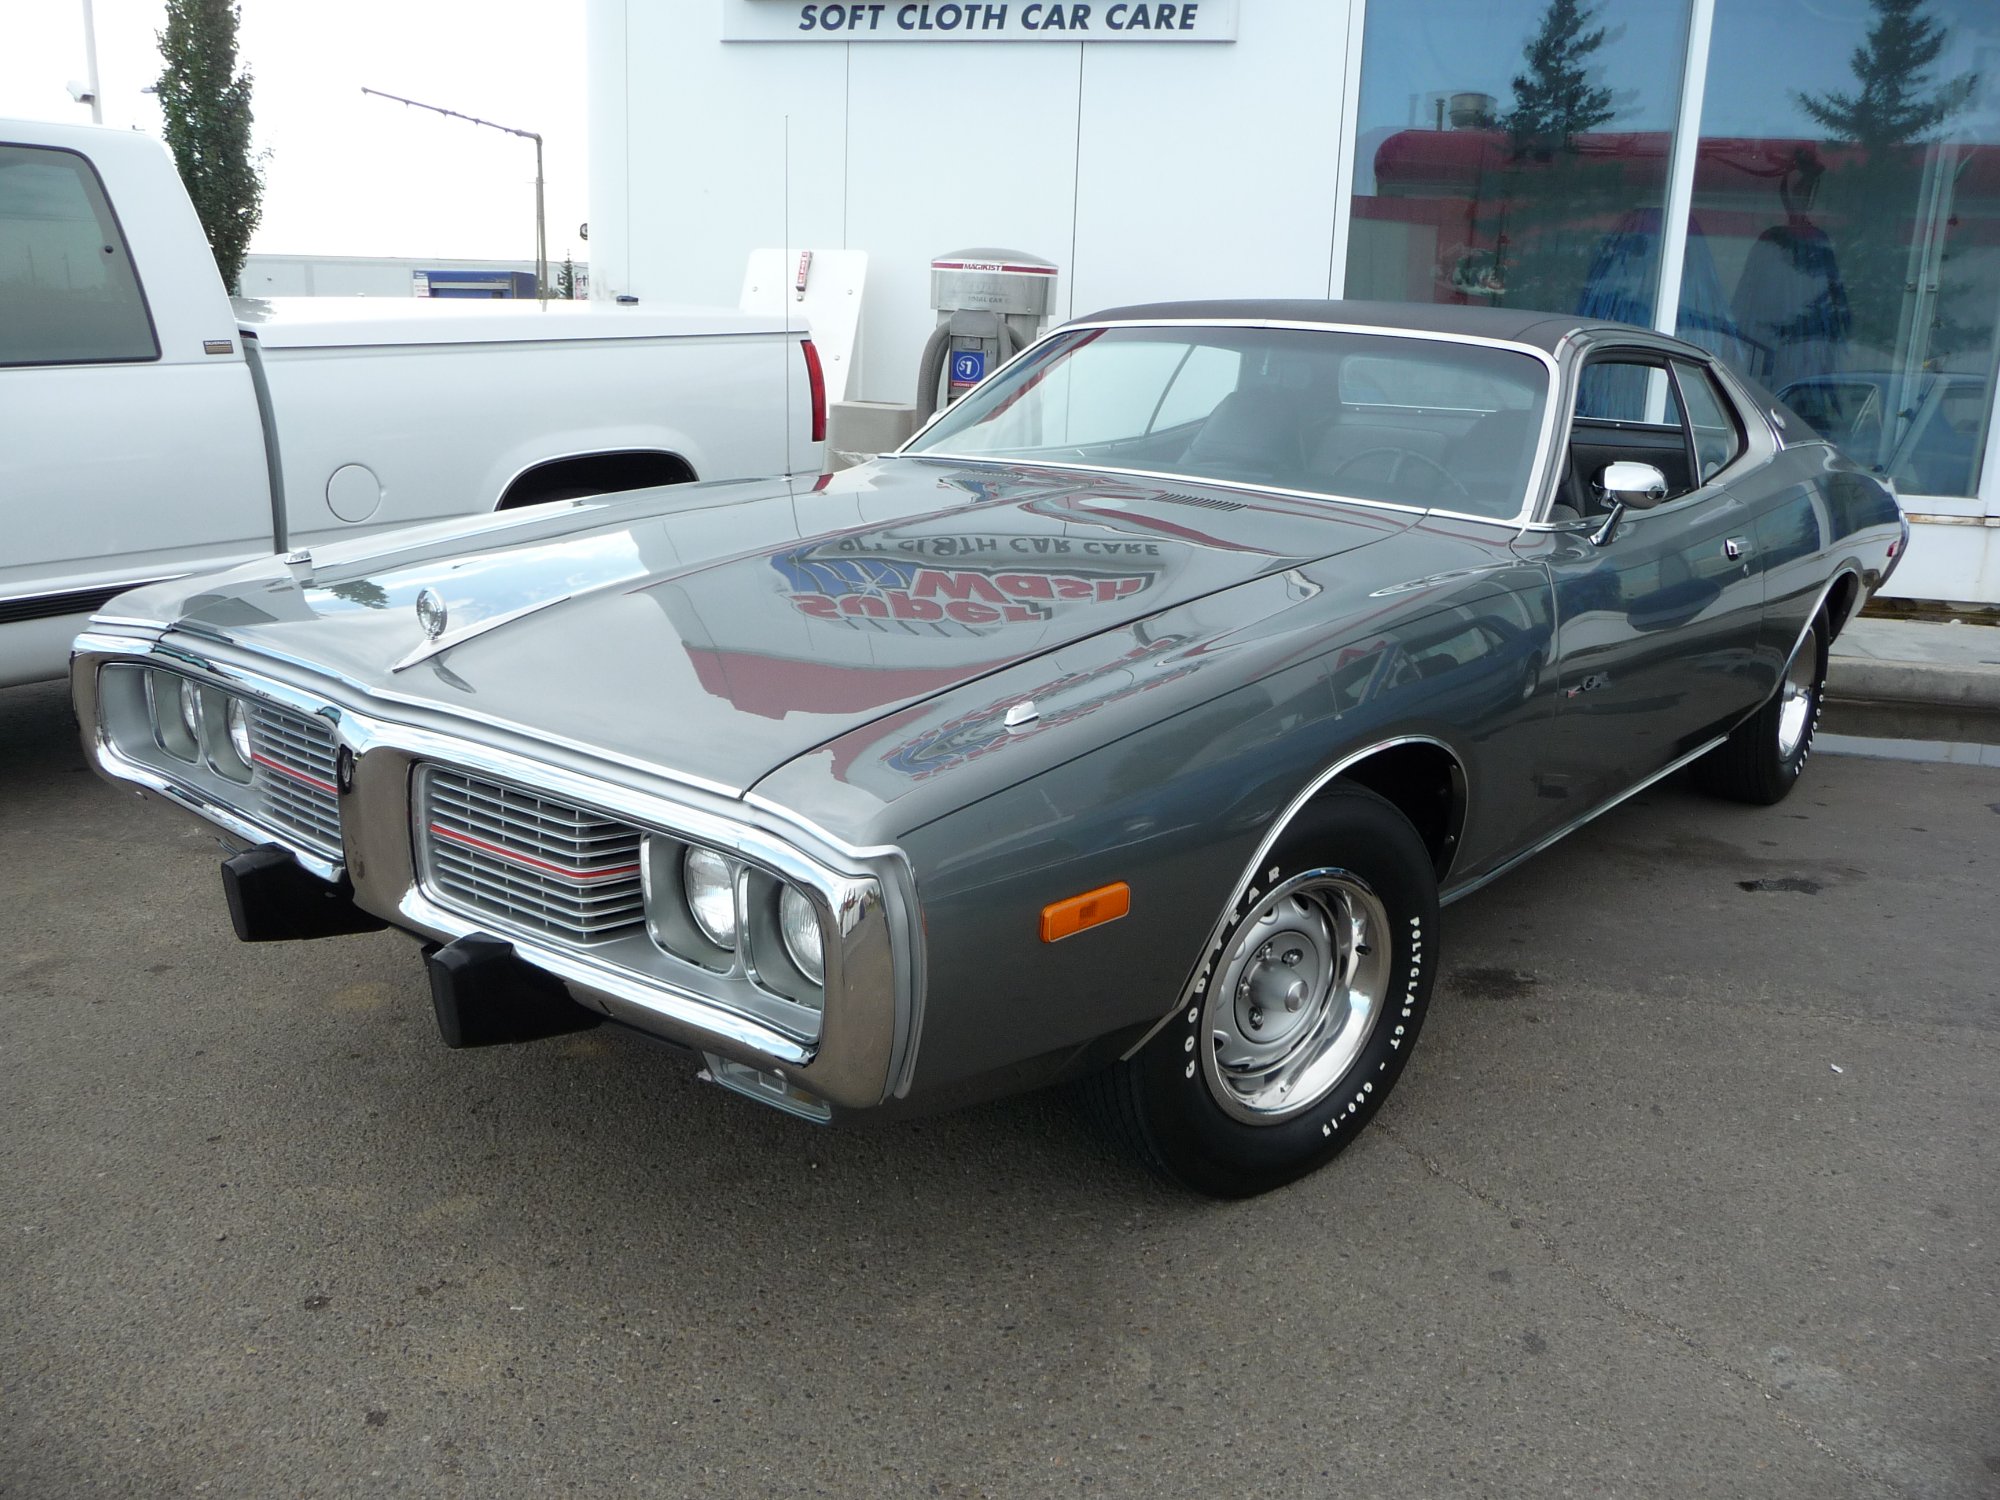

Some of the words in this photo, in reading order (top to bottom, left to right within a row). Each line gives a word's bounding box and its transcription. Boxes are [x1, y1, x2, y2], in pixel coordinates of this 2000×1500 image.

[798, 4, 885, 31] SOFT
[896, 4, 1008, 31] CLOTH
[1021, 3, 1092, 31] CAR
[1105, 3, 1199, 31] CARE
[963, 263, 1001, 271] MAGIKIST
[1184, 866, 1280, 1079] GOODEAR
[1402, 916, 1422, 1018] POLYGLAS
[1390, 1025, 1405, 1050] GT
